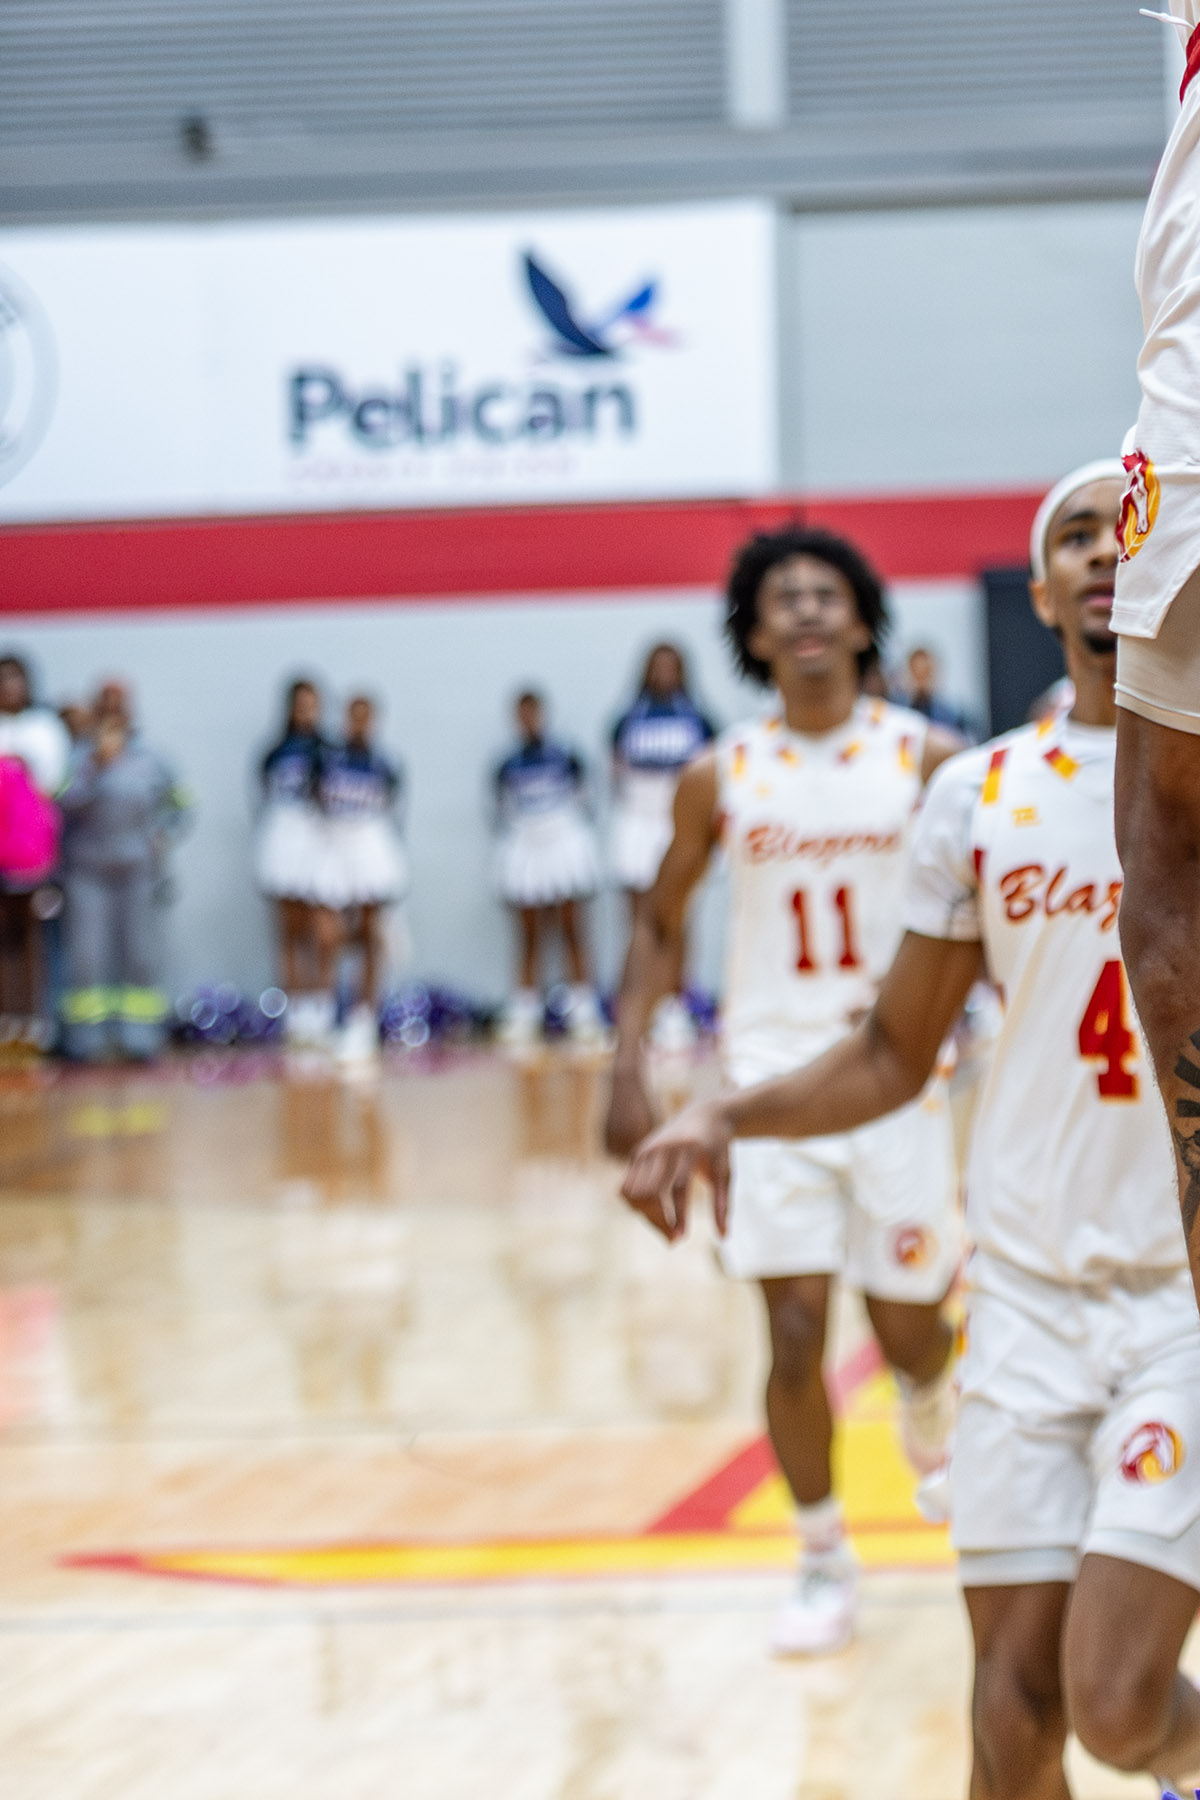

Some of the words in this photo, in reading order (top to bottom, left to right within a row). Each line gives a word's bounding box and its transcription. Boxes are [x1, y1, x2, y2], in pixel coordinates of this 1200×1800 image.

[286, 363, 639, 452] Pelican
[787, 885, 864, 974] 11
[1000, 864, 1124, 931] Blaz
[1078, 958, 1142, 1104] 4
